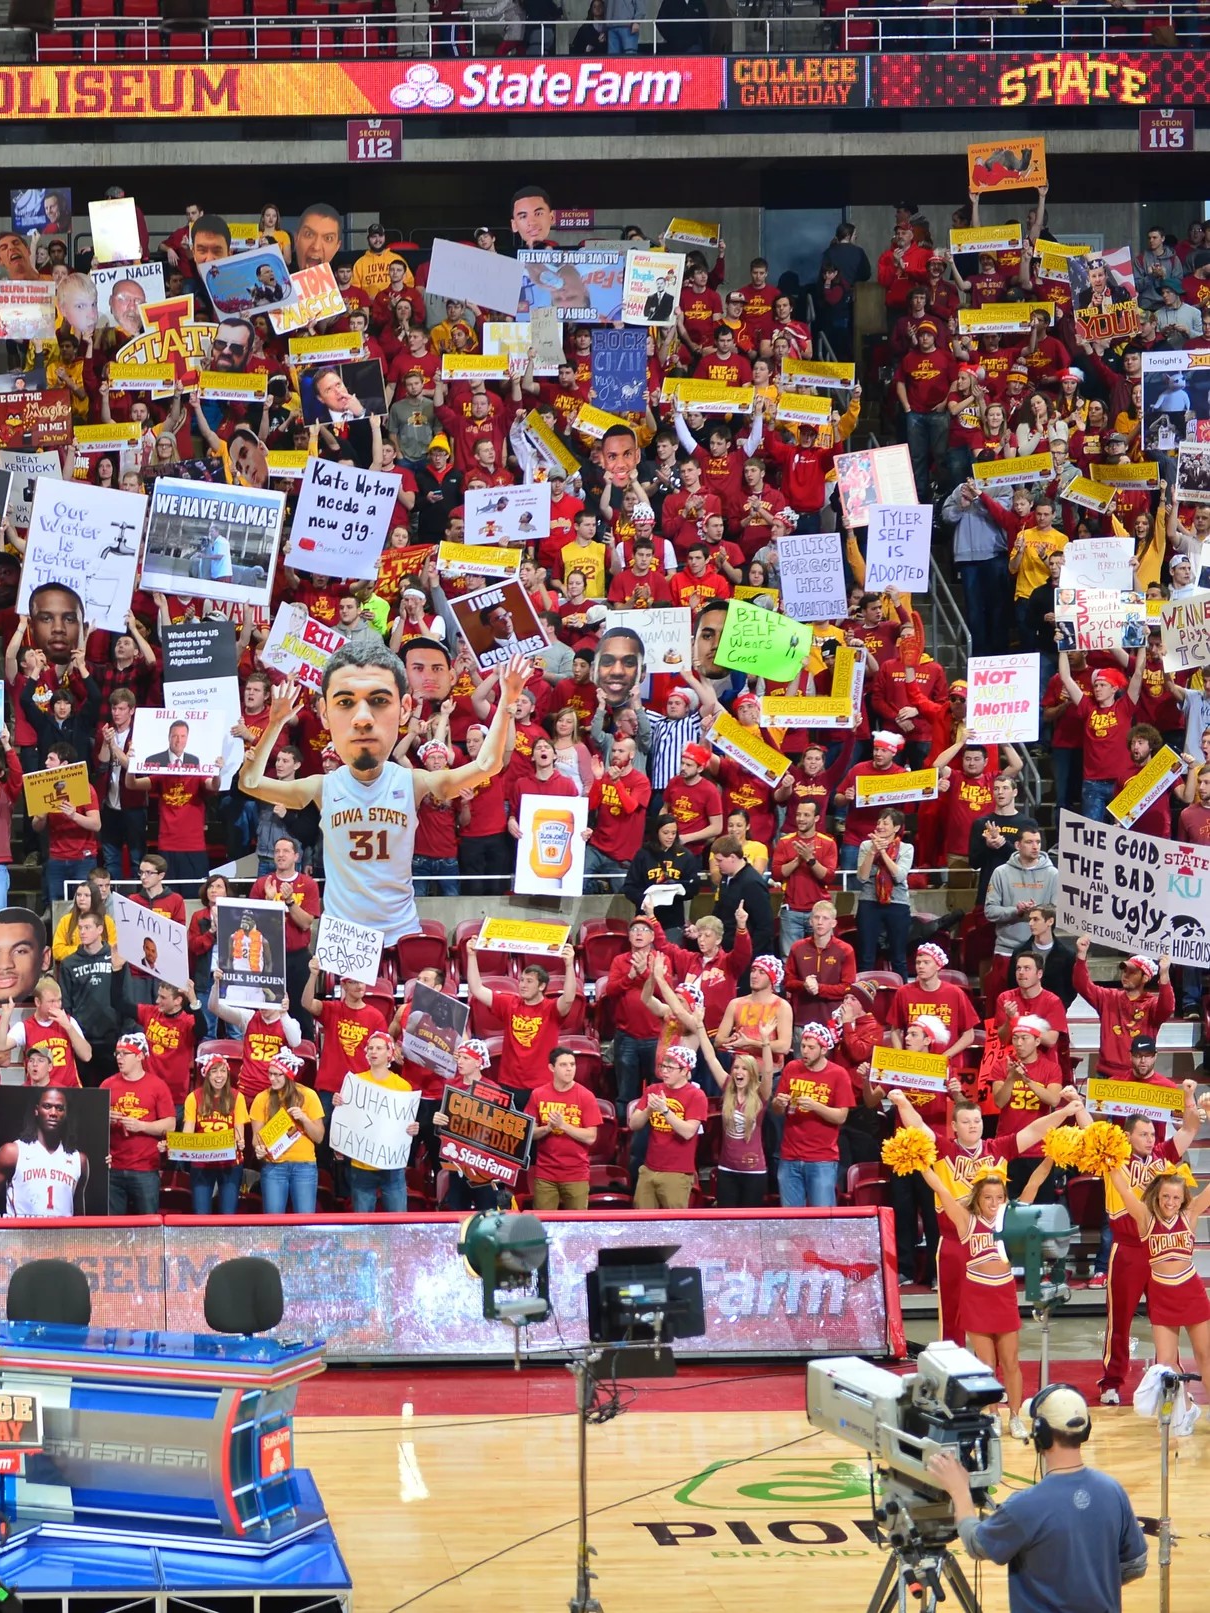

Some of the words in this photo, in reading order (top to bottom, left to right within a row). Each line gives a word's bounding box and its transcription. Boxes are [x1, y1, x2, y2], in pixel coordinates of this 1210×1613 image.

[734, 58, 858, 84] COLLEGE
[999, 60, 1147, 105] STATE
[741, 85, 851, 105] GAMEDAY
[359, 129, 390, 137] SECTION
[1149, 128, 1184, 147] 113
[357, 140, 392, 158] 112
[560, 219, 590, 227] 212-213
[954, 228, 1015, 240] CYCLONES
[1076, 306, 1099, 317] FRED
[1104, 300, 1137, 315] WANTS
[1077, 313, 1140, 340] YOU!
[1148, 357, 1182, 366] Tonight's
[8, 394, 25, 402] GOT
[28, 392, 42, 401] THE
[4, 463, 56, 473] KENTUCKY
[15, 456, 39, 464] BEAT
[978, 458, 1047, 474] CYCLONES
[311, 461, 349, 492] Kate
[355, 475, 395, 498] Upton
[157, 493, 179, 514] WE
[179, 496, 217, 520] HAVE
[218, 502, 279, 529] LLAMAS
[316, 494, 361, 515] needs
[367, 504, 376, 516] a
[878, 509, 923, 525] TYLER
[308, 515, 341, 530] new
[341, 520, 375, 541] gig.
[878, 528, 914, 542] SELF
[888, 545, 904, 558] IS
[868, 564, 924, 584] ADOPTED
[466, 597, 477, 611] I
[477, 588, 506, 608] LOVE
[168, 632, 185, 640] What
[197, 630, 208, 638] the
[209, 629, 219, 637] US
[480, 634, 545, 667] CYCLONES
[973, 656, 1029, 666] HILTON
[974, 670, 1016, 686] NOT
[155, 710, 177, 720] BILL
[184, 711, 209, 720] SELF
[767, 701, 846, 712] CYCLONES
[973, 700, 1030, 715] ANOTHER
[136, 762, 160, 772] USES
[167, 762, 214, 773] MYSPACE
[29, 777, 56, 786] SITTING
[59, 771, 83, 780] DOWN
[331, 809, 363, 827] IOWA
[368, 808, 408, 828] STATE
[349, 830, 391, 860] 31
[1065, 821, 1108, 850] THE
[1115, 836, 1160, 869] GOOD,
[1062, 852, 1103, 881] THE
[1115, 864, 1156, 897] BAD,
[1089, 881, 1109, 895] AND
[1168, 875, 1203, 899] KU
[1062, 884, 1104, 914] THE
[1111, 894, 1167, 938] Ugly
[324, 918, 377, 943] JAYHAWKS
[318, 945, 354, 967] REAL
[356, 942, 379, 955] EVEN
[1172, 939, 1210, 963] HIDEOUS
[337, 953, 372, 974] BIRDS
[246, 974, 285, 984] HOGUEN
[473, 1085, 510, 1106] ESPN
[1094, 1082, 1183, 1106] CYCLONES
[448, 1092, 528, 1136] COLLEGE
[449, 1115, 520, 1154] GAMEDAY
[23, 1169, 48, 1182] IOWA
[49, 1168, 77, 1188] STATE
[46, 1185, 54, 1210] 1
[1150, 1233, 1193, 1254] CYCLONES
